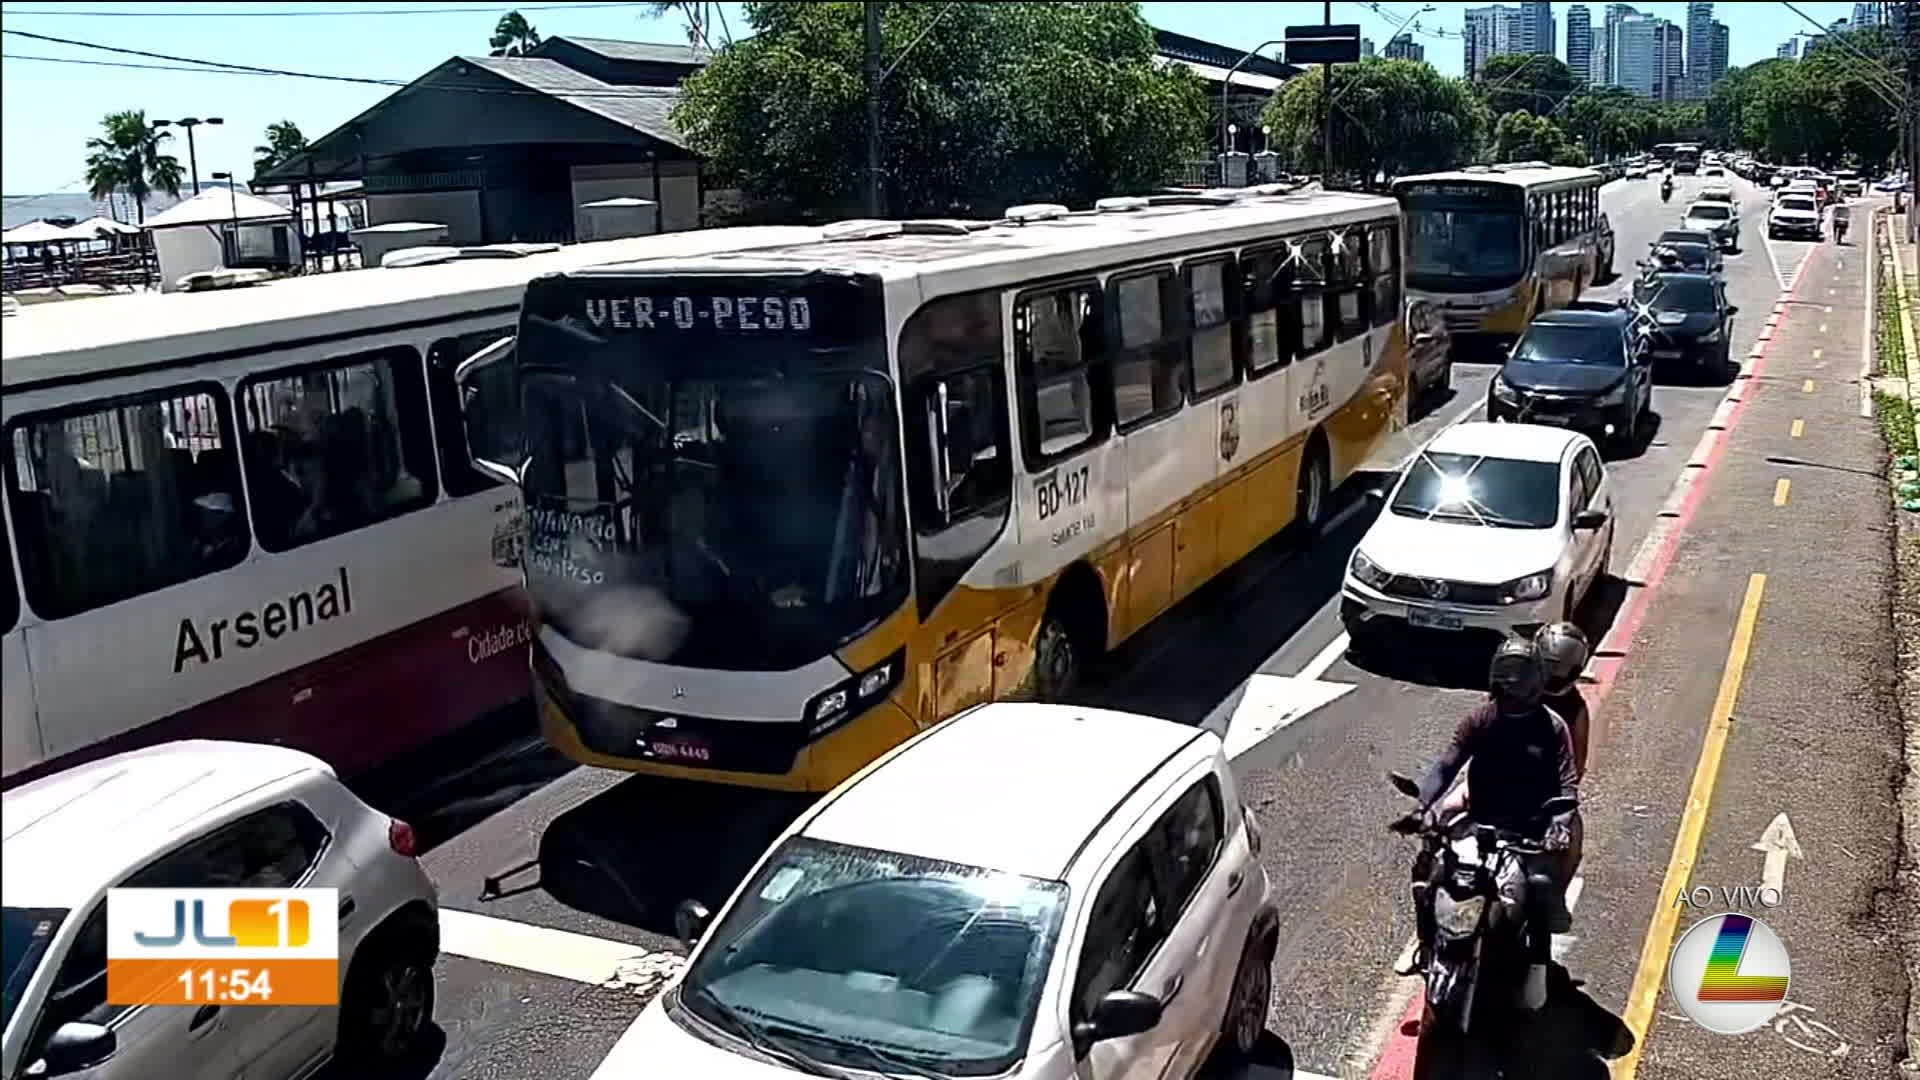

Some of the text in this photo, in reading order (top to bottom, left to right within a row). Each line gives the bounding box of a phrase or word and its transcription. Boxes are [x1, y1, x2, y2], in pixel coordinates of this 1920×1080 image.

[586, 297, 811, 330] VER-O-PESO
[1038, 465, 1089, 520] BD-127
[173, 566, 351, 673] Arsenal
[468, 624, 515, 664] Cidade
